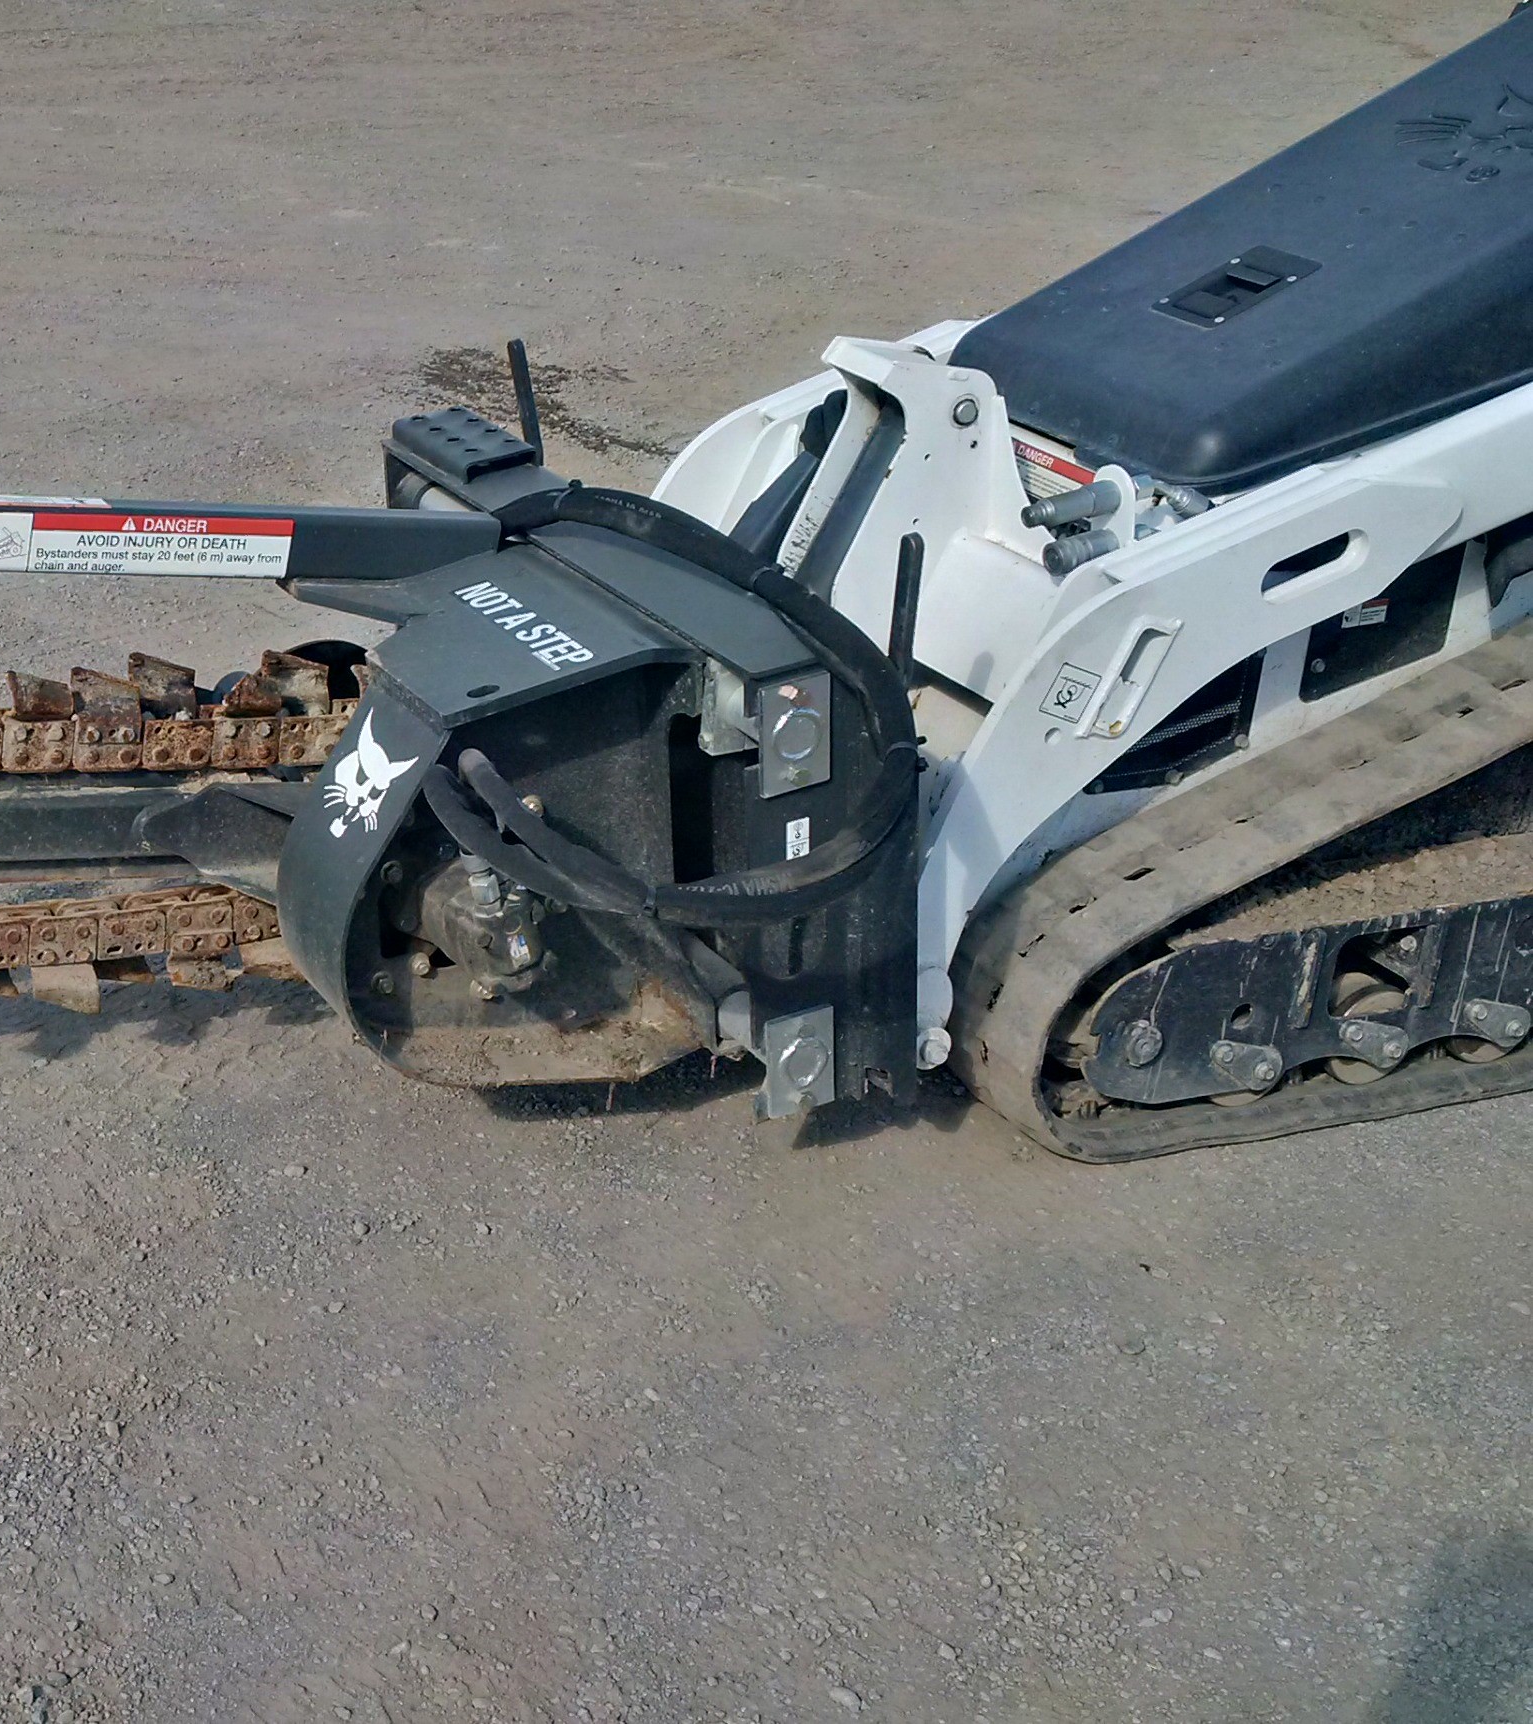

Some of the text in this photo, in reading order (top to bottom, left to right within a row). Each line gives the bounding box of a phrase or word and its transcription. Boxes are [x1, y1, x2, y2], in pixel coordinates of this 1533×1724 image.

[1016, 444, 1055, 469] DANGER
[142, 517, 208, 533] DANGER
[76, 534, 247, 551] AVOID INJURY OR DEATH
[35, 547, 282, 565] Bystanders must stay 20 feet (6 m) away from
[34, 560, 126, 573] chain and auger.
[454, 581, 595, 667] NOT A STEP
